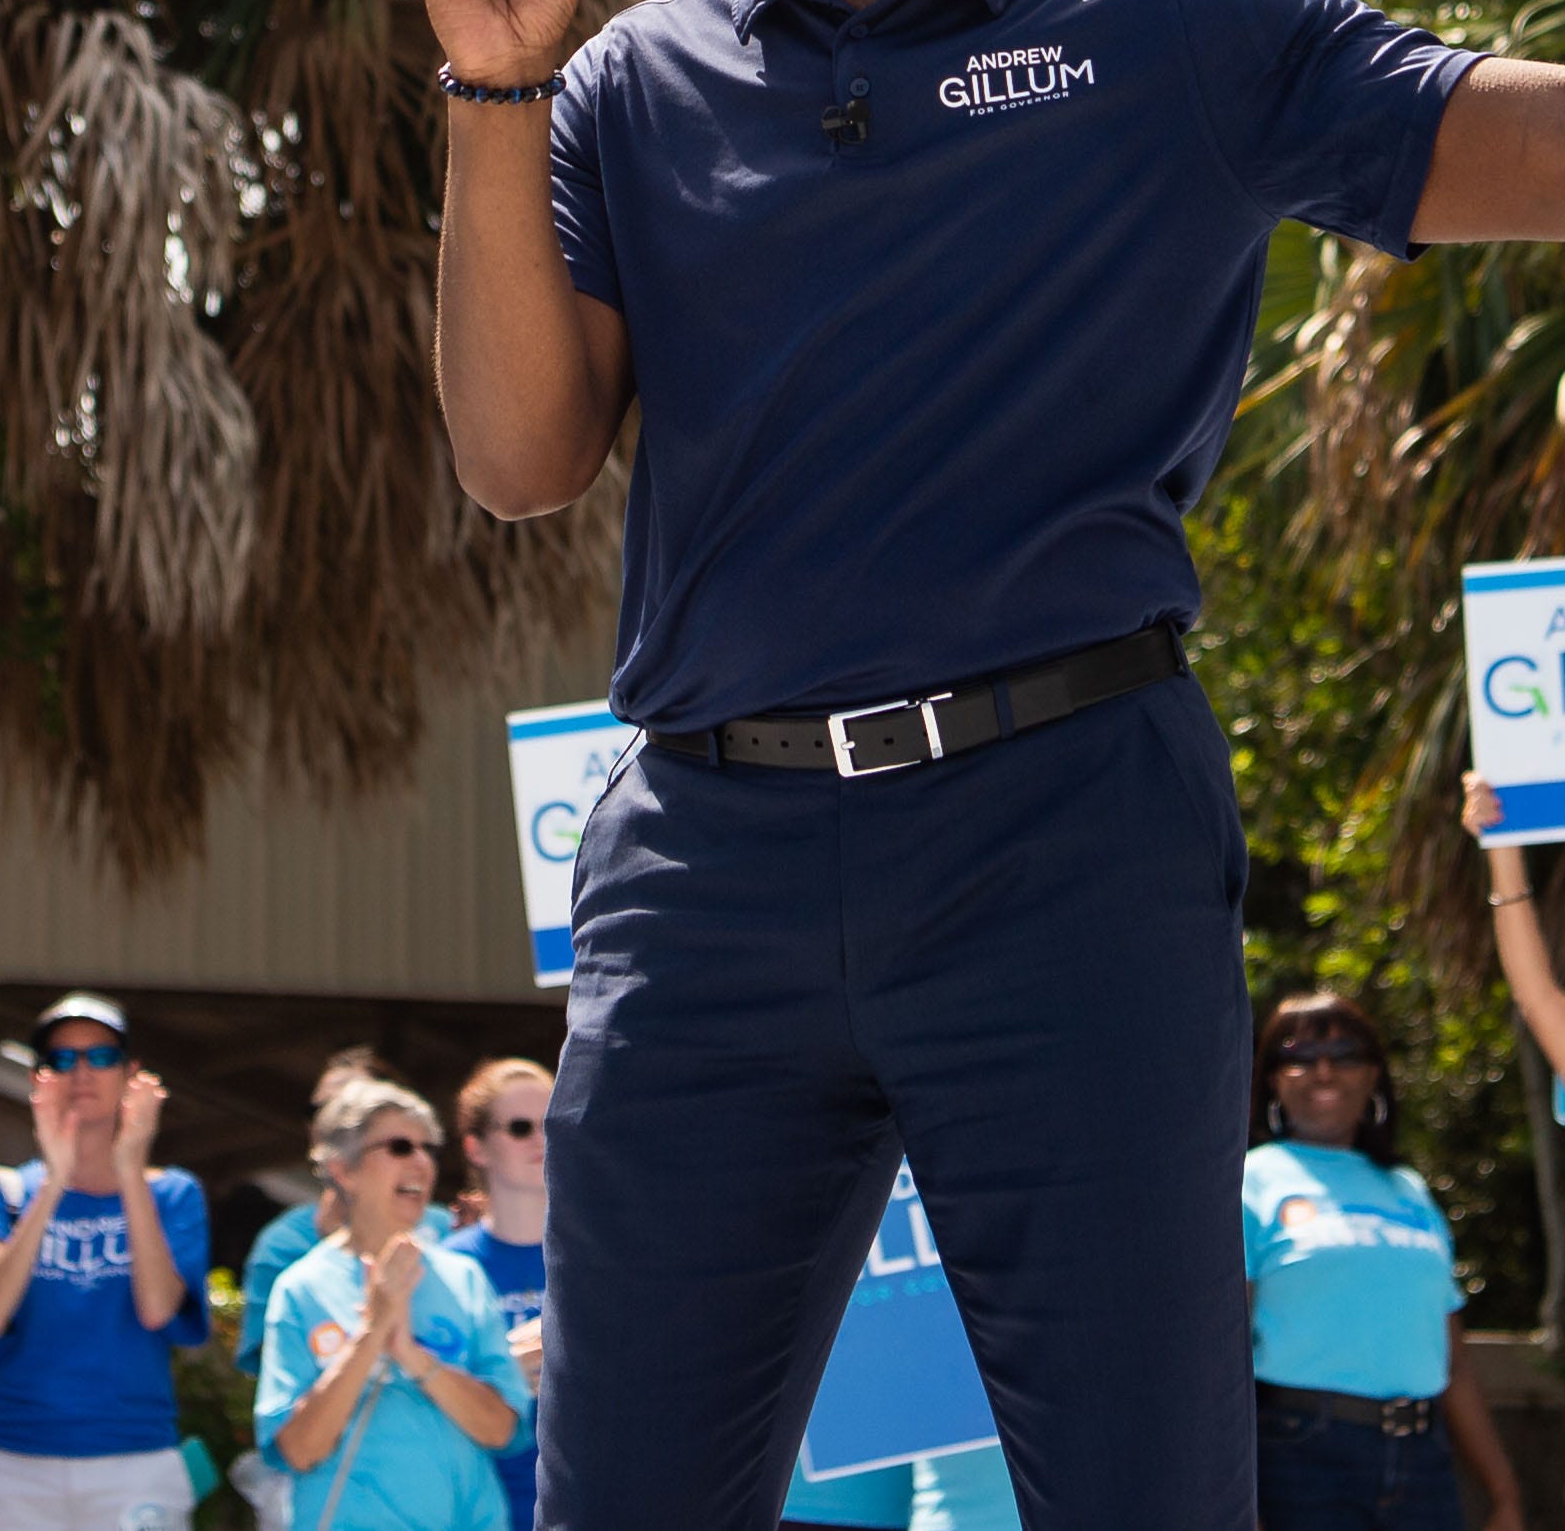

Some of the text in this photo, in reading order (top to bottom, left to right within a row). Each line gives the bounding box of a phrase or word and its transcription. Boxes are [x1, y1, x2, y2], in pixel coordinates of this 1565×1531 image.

[966, 45, 1063, 72] ANDREW
[939, 59, 1095, 108] GILLUM
[969, 91, 1070, 117] FOR GOVERNOR
